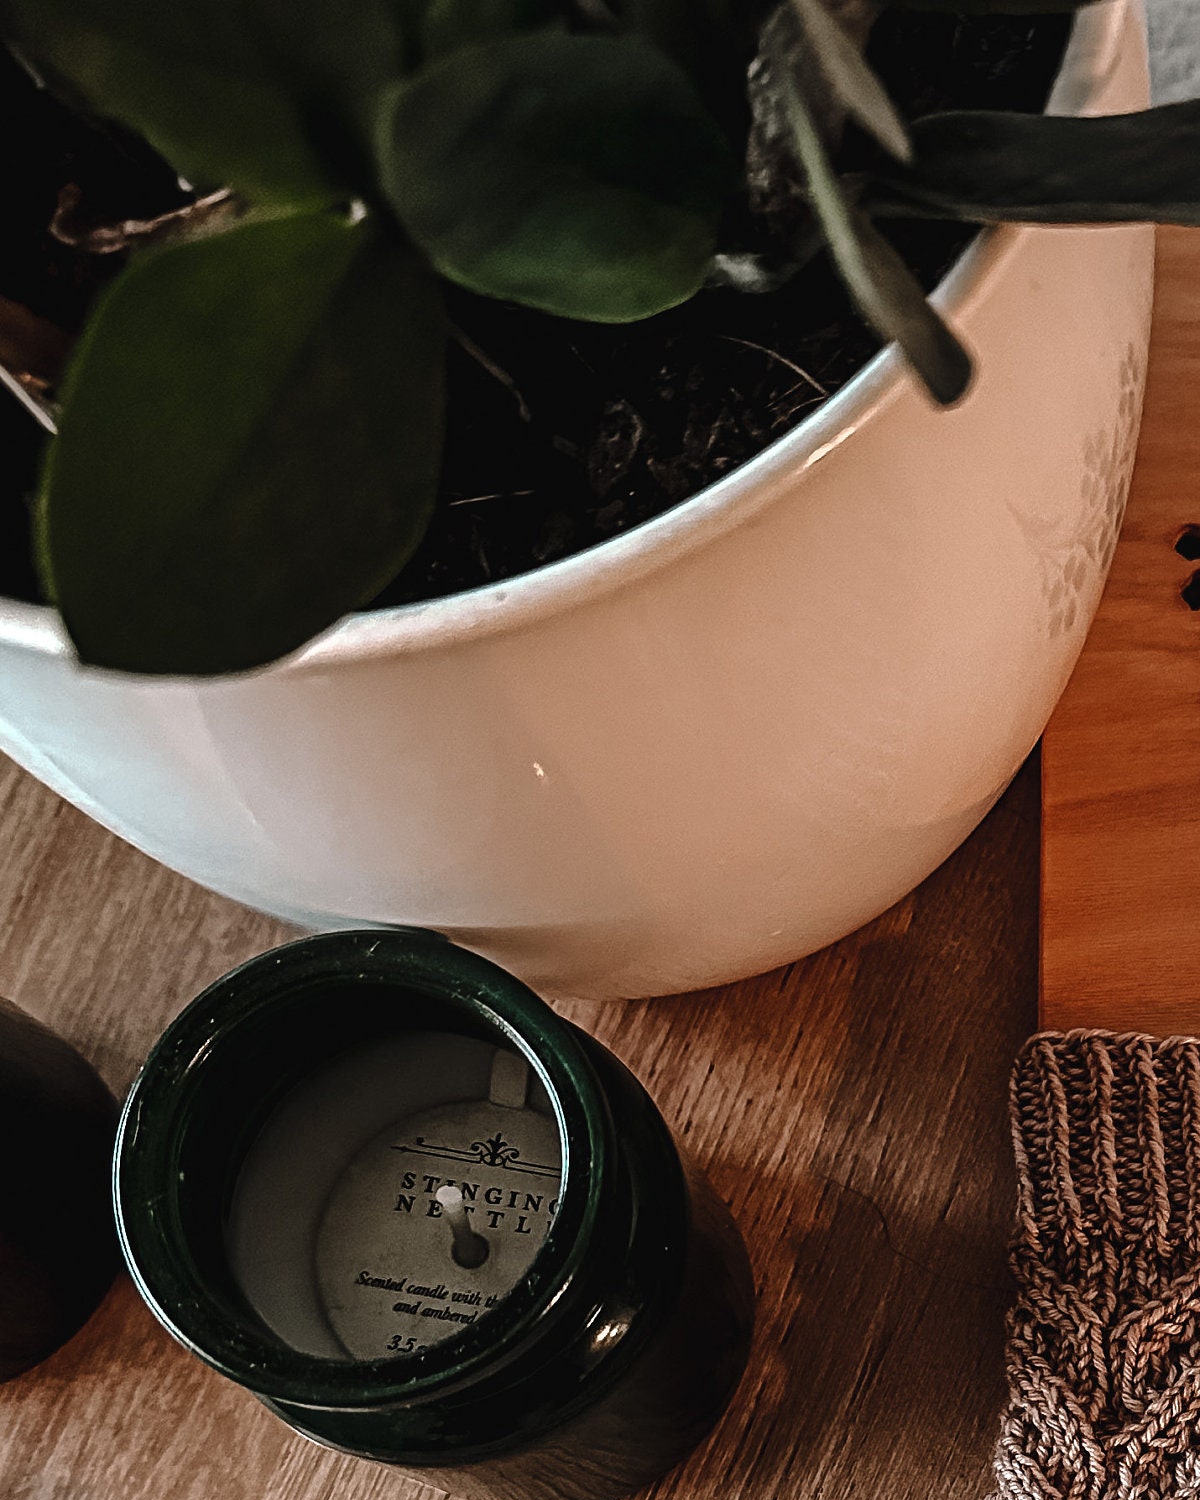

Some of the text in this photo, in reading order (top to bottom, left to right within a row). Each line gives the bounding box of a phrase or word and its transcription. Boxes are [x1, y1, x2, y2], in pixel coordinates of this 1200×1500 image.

[401, 1172, 560, 1215] STNGIN
[394, 1194, 553, 1234] NETL
[356, 1271, 408, 1292] Scented
[406, 1283, 449, 1300] candle
[451, 1289, 482, 1307] with
[392, 1301, 423, 1315] and
